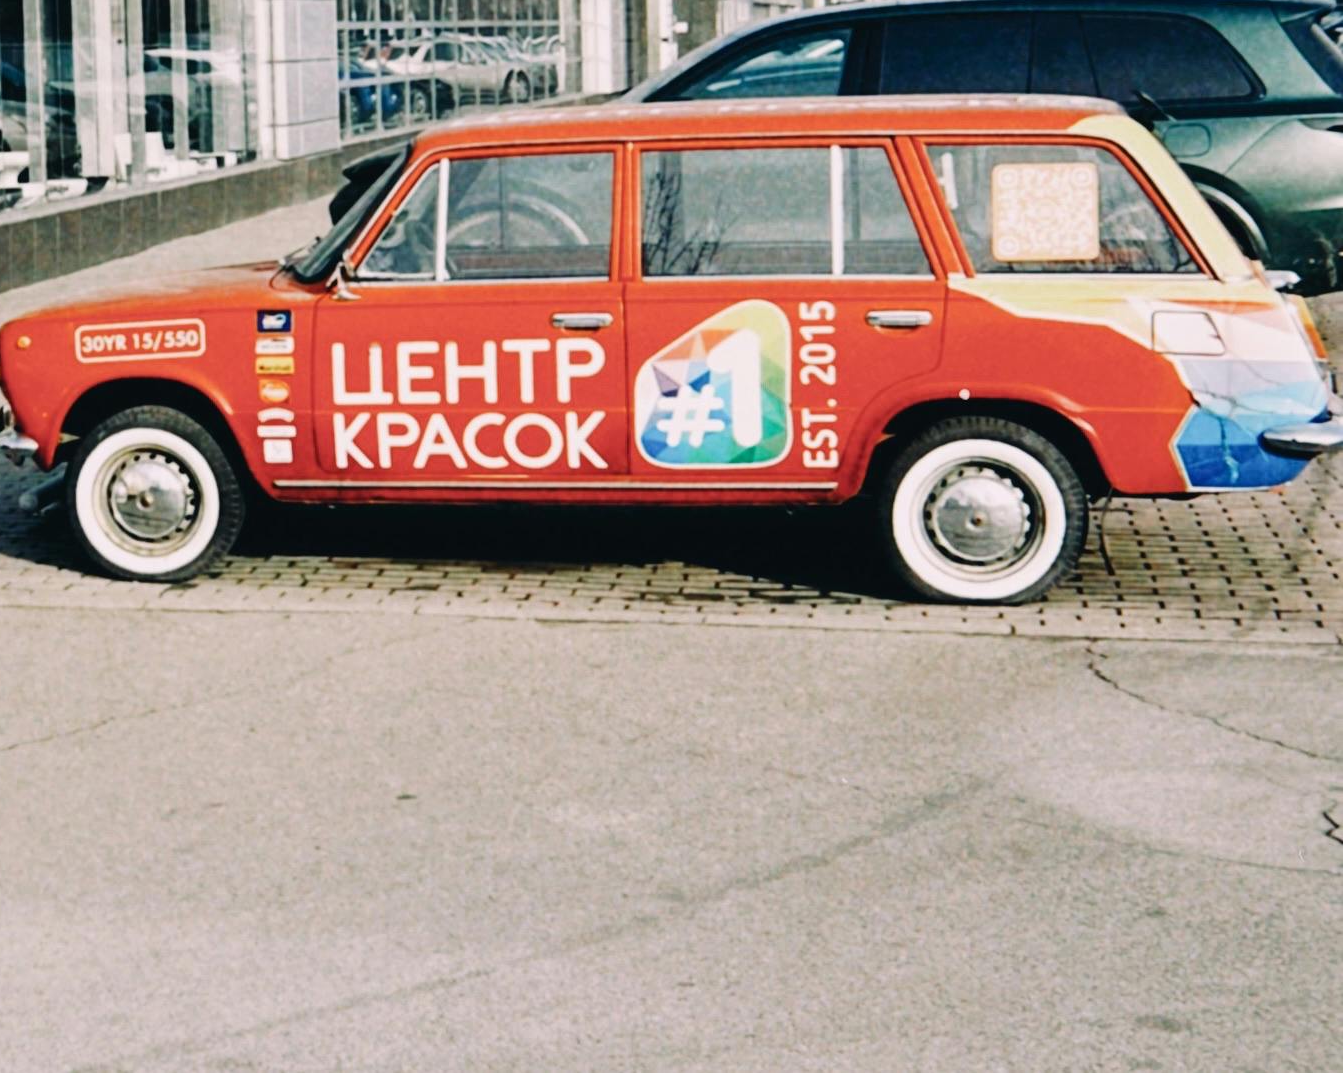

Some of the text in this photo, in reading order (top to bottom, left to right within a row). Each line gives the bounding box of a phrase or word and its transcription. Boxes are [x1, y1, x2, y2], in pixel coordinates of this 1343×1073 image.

[81, 329, 199, 353] 30YR 15/550
[331, 337, 606, 406] ЦЕНТР
[656, 328, 763, 448] #1
[798, 300, 839, 468] EST. 2015
[333, 411, 609, 469] КРАСОК
